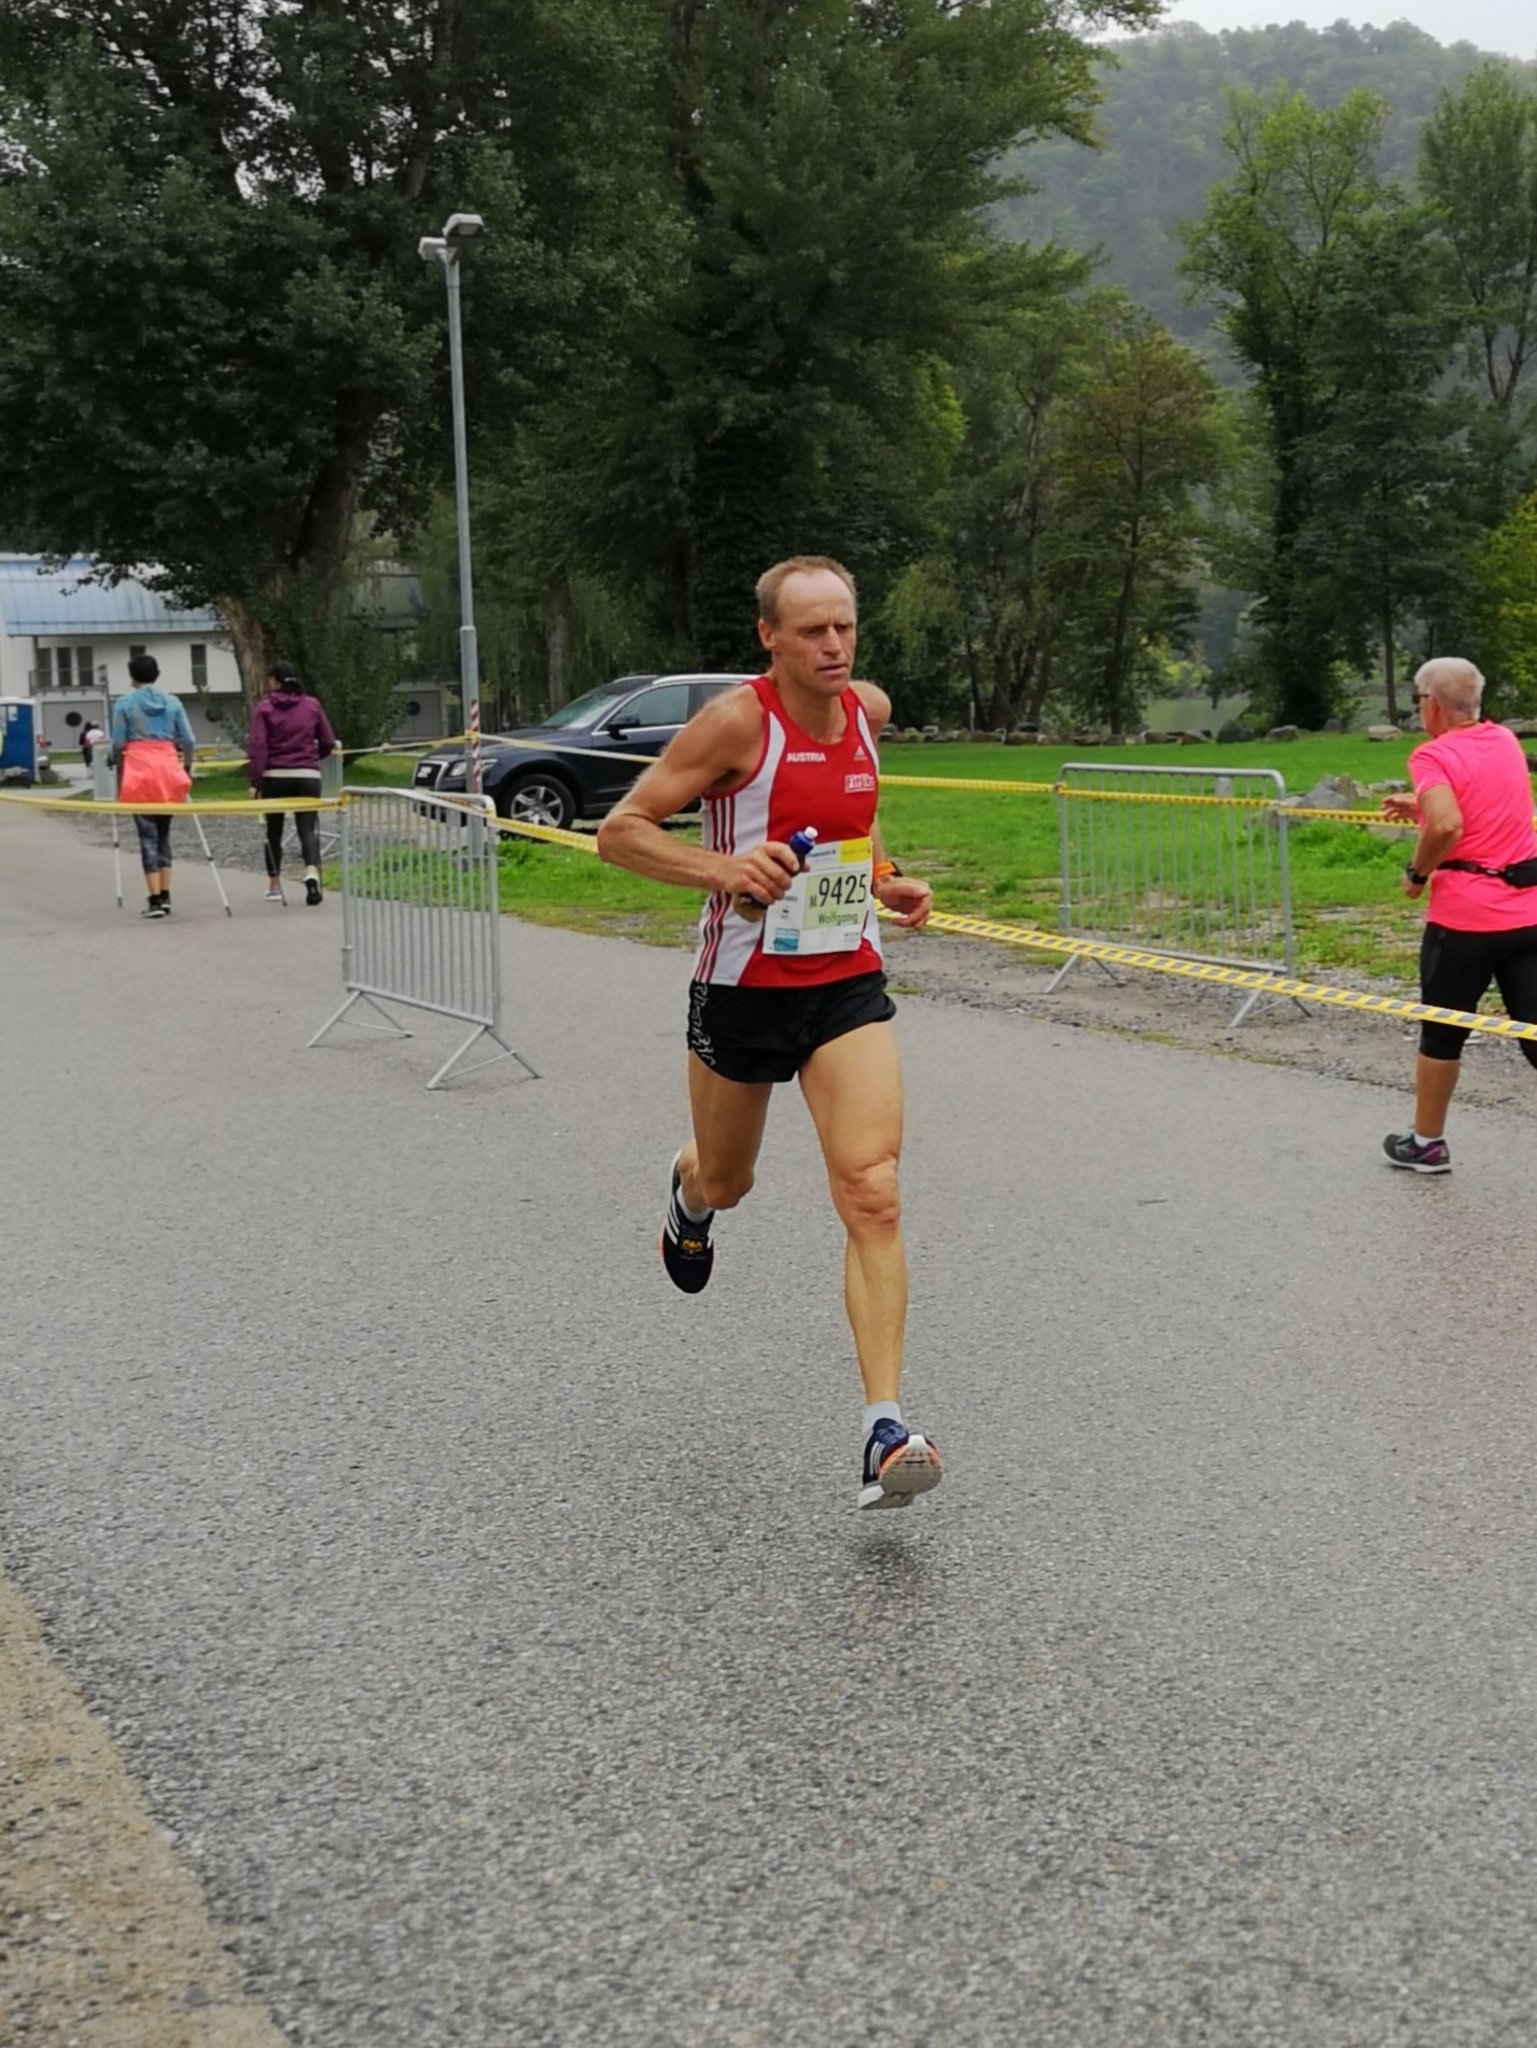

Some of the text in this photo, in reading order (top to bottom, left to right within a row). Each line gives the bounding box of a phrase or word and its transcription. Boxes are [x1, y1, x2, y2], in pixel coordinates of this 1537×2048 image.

[786, 752, 826, 763] AUSTRIA
[818, 873, 867, 907] 9425
[818, 910, 858, 926] Wolfgang
